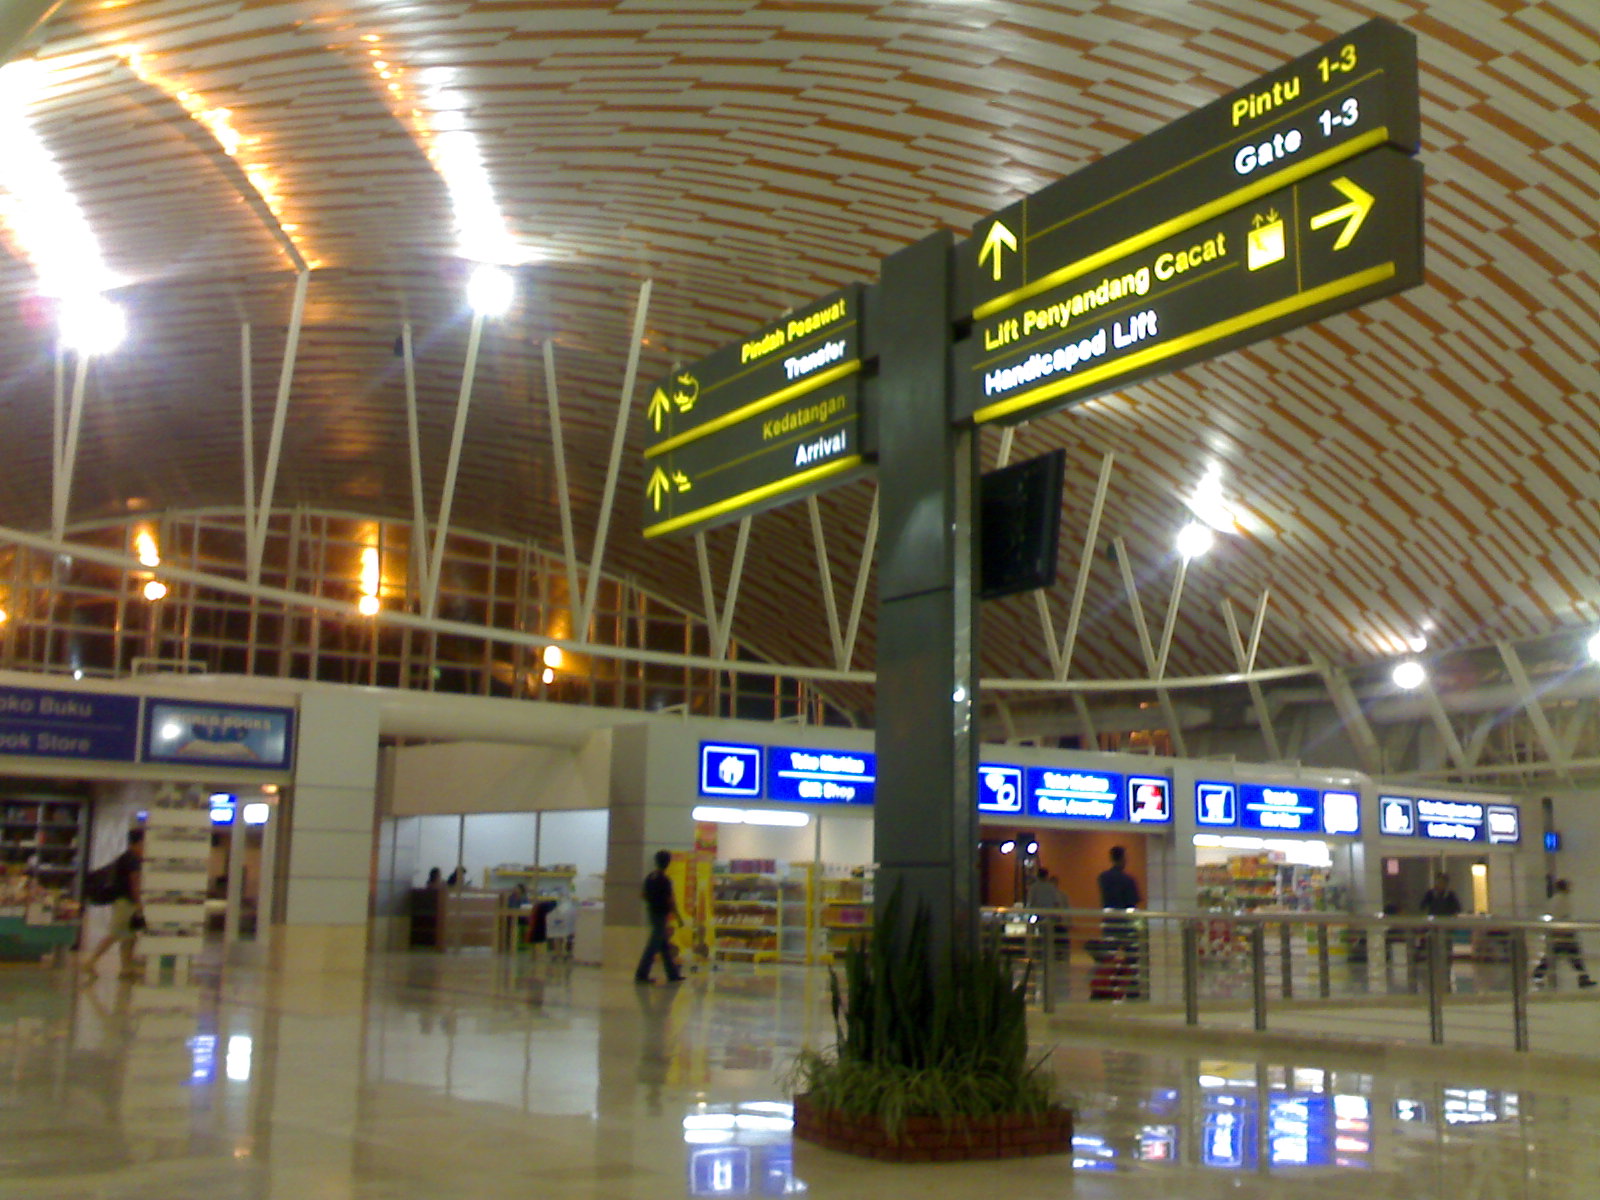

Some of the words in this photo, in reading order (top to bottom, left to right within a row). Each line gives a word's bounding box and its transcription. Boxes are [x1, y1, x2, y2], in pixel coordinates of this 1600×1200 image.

[1232, 76, 1301, 127] Pintu
[1317, 43, 1359, 83] 1-3
[1234, 128, 1303, 175] Gate
[1318, 97, 1361, 137] 1-3
[985, 321, 1020, 351] Lift
[1022, 263, 1151, 336] Penyandang
[1153, 232, 1228, 282] Cacat
[742, 328, 785, 363] Pindah
[788, 298, 846, 340] Pesawat
[1112, 309, 1159, 350] Lift
[763, 395, 846, 440] Kedatangan
[795, 429, 846, 466] Arrival
[0, 694, 34, 713] oko
[39, 695, 93, 718] Buku
[36, 731, 93, 753] Store
